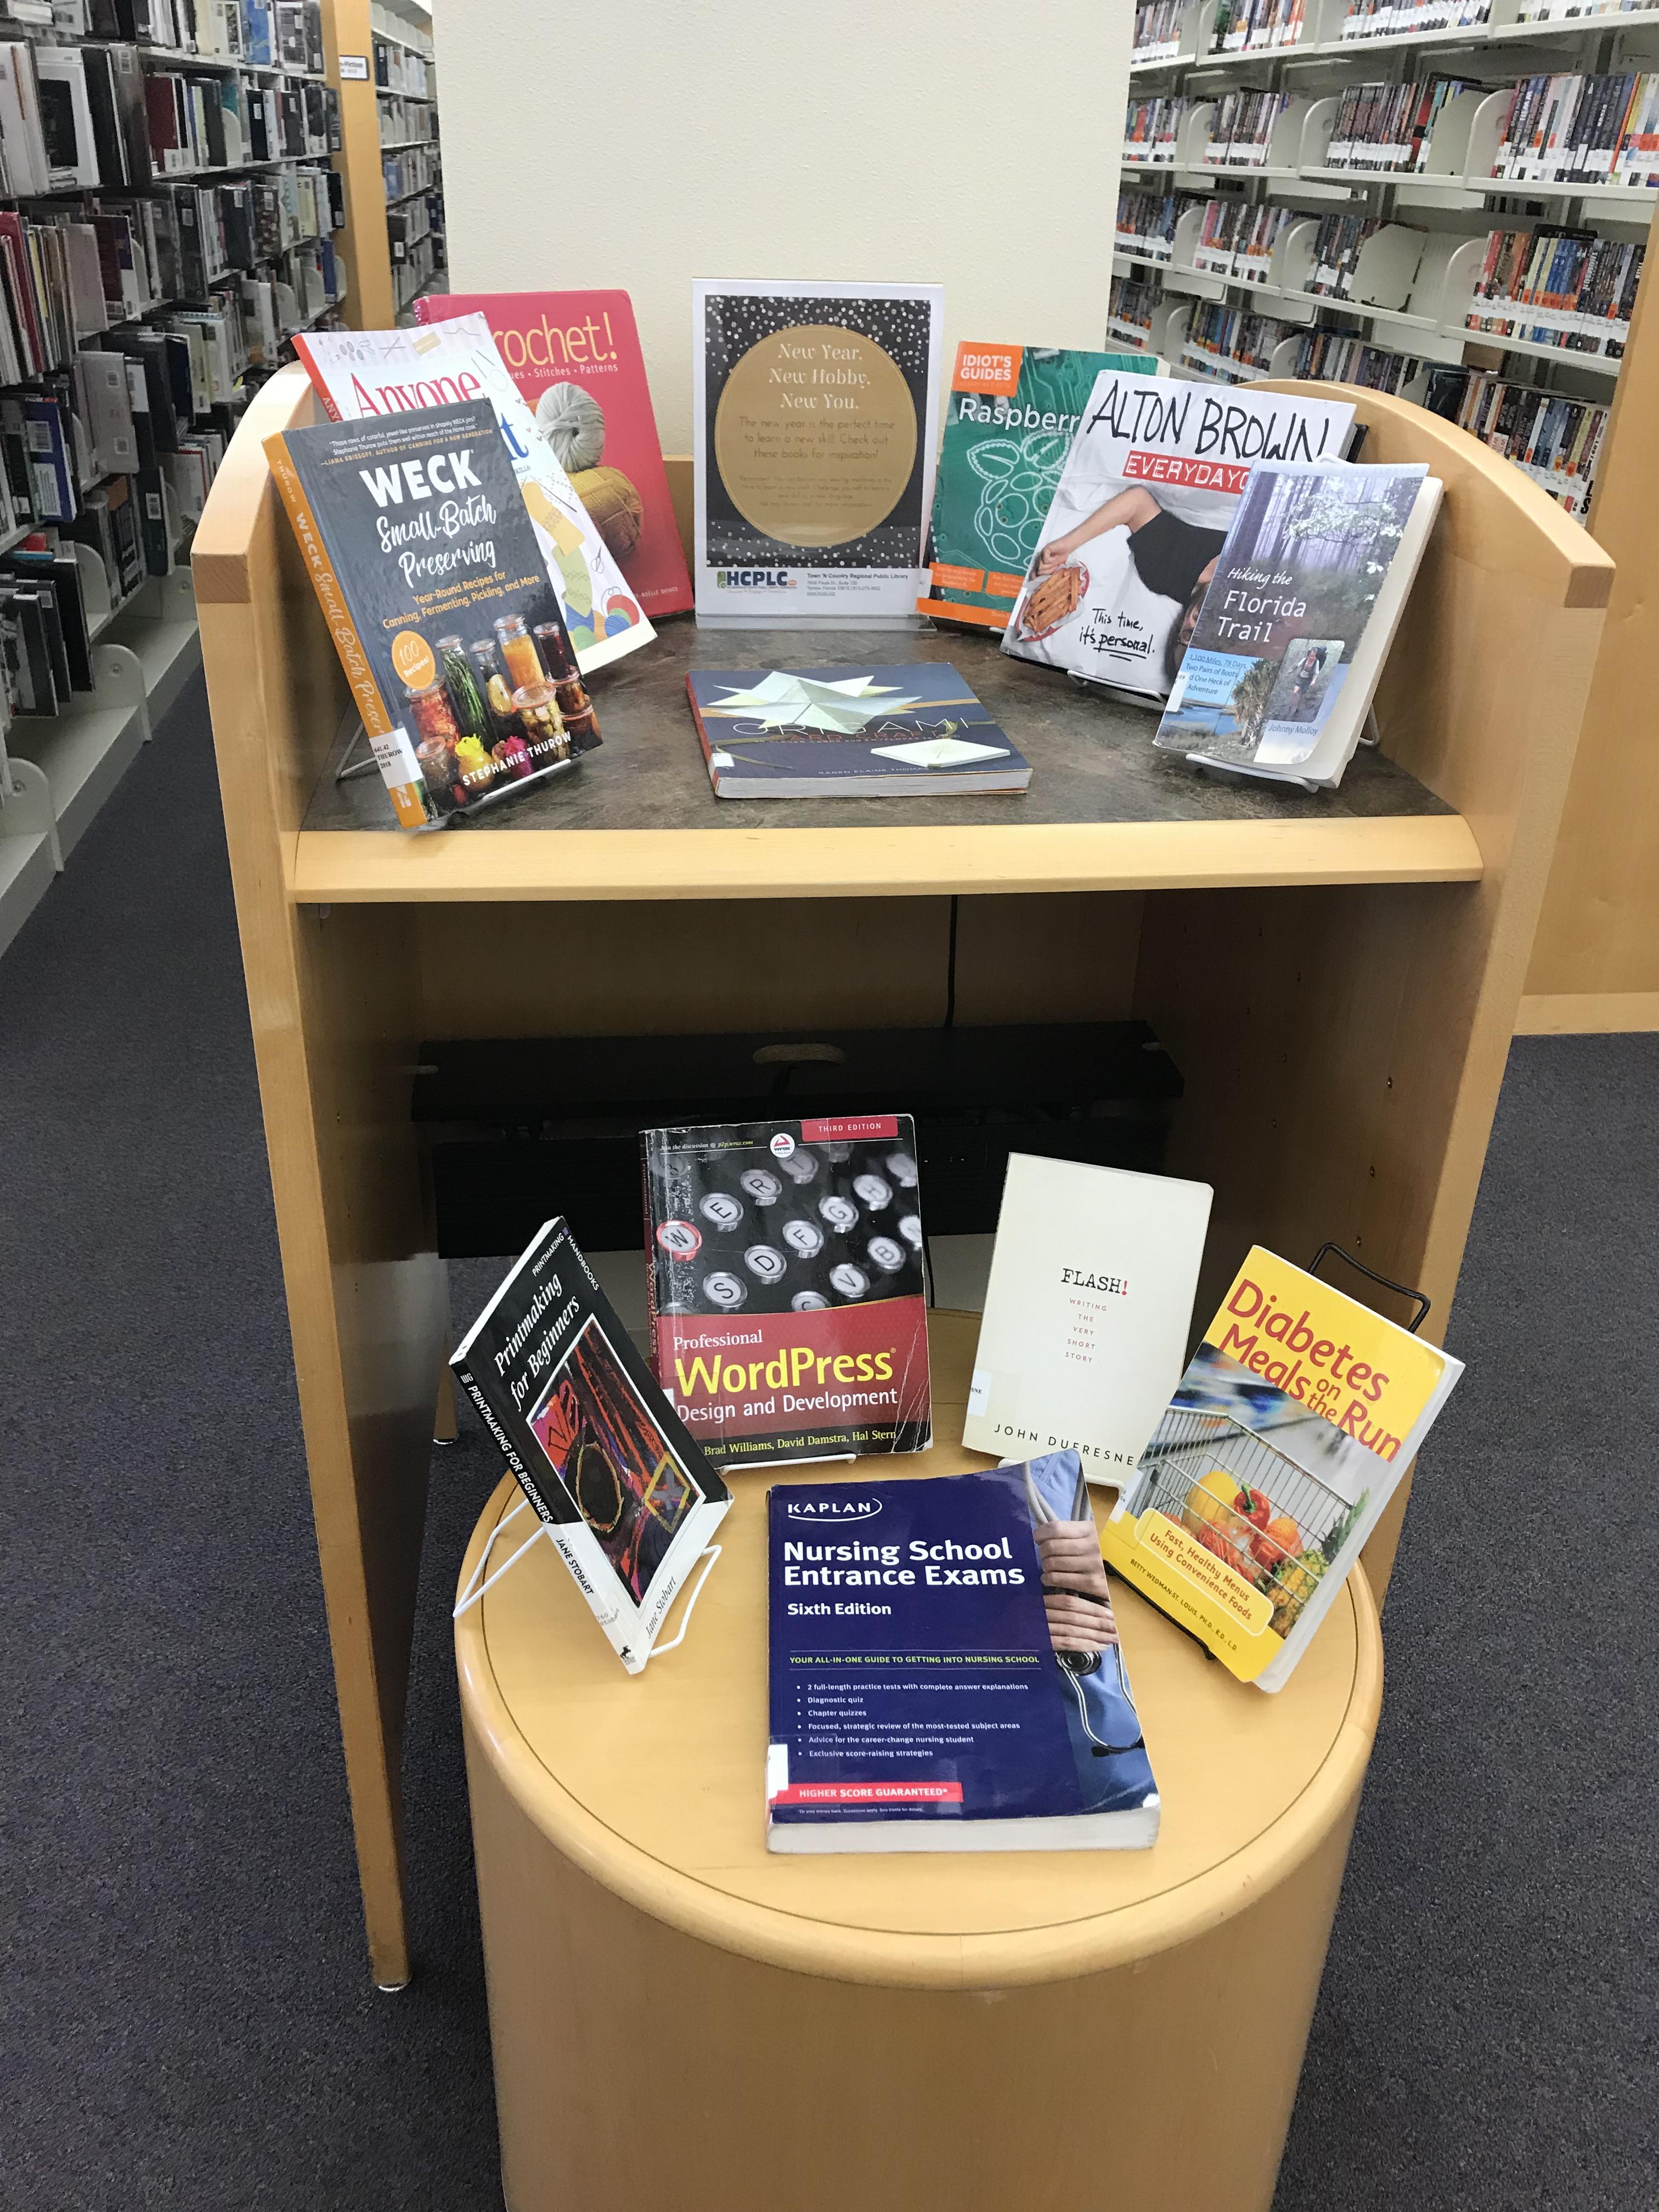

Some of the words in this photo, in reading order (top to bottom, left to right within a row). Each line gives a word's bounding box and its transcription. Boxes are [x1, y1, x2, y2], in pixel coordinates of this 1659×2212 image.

[778, 343, 815, 358] New
[822, 344, 862, 360] Year.
[963, 354, 1012, 368] IDIOT'S
[534, 365, 571, 377] Stitches
[579, 363, 618, 374] Patterns
[769, 368, 806, 383] New
[812, 368, 871, 388] Hobby.
[960, 368, 1012, 381] GUIDES
[780, 393, 817, 408] New
[823, 393, 859, 409] You.
[739, 416, 757, 427] The
[785, 421, 805, 430] year
[819, 417, 834, 428] the
[838, 418, 870, 430] perfect
[874, 419, 895, 430] time
[959, 397, 1081, 433] Raspberr
[1086, 379, 1191, 444] ALTON
[1194, 398, 1330, 462] BROWN
[277, 459, 297, 503] THUROW
[1125, 454, 1250, 490] EVERYDAYC
[376, 494, 496, 553] Small-Batch
[399, 540, 496, 588] Preserving
[413, 584, 461, 605] Year-Round
[462, 574, 493, 591] Recipes
[494, 571, 506, 581] for
[726, 571, 788, 586] HCPLC
[1227, 567, 1271, 590] Hiking
[1272, 571, 1293, 585] the
[296, 511, 323, 568] WECK
[315, 572, 363, 680] Small-Batch
[383, 611, 421, 629] Canning,
[421, 596, 471, 617] Fermenting,
[472, 585, 505, 602] Pickling,
[505, 581, 520, 591] and
[521, 575, 540, 586] More
[1223, 590, 1307, 618] Florida
[1092, 608, 1112, 625] This
[1118, 611, 1143, 631] time,
[1218, 616, 1273, 642] Trail
[1079, 625, 1096, 646] it's
[1098, 633, 1155, 653] personal.
[399, 640, 420, 666] 100
[403, 655, 431, 678] Recipes!
[1186, 663, 1198, 671] Two
[1199, 665, 1213, 674] Pairs
[1187, 684, 1219, 695] Adventure
[1208, 678, 1223, 686] Heck
[733, 717, 969, 735] ORIGAMI
[1268, 724, 1295, 735] Johnny
[1295, 726, 1319, 736] Molloy
[377, 748, 403, 760] THUROW
[462, 751, 526, 786] STEPHANIE
[527, 731, 572, 759] THUROW
[848, 1122, 882, 1131] EDITION
[532, 1232, 565, 1277] PRINTMAKING
[567, 1235, 600, 1291] HANDBOOKS
[1061, 1268, 1127, 1296] FLASH!
[1070, 1298, 1107, 1311] WRITING
[494, 1273, 563, 1377] Printmaking
[1078, 1314, 1094, 1323] THE
[673, 1329, 763, 1351] Professional
[1074, 1327, 1094, 1336] VERY
[1227, 1278, 1391, 1402] Diabetes
[511, 1371, 529, 1412] for
[527, 1295, 579, 1379] Beginners
[1067, 1339, 1096, 1350] SHORT
[1065, 1352, 1093, 1363] STORY
[1219, 1323, 1311, 1401] Meals
[1317, 1379, 1341, 1402] on
[678, 1404, 736, 1423] Design
[743, 1397, 775, 1415] and
[783, 1387, 898, 1412] Development
[1306, 1393, 1338, 1423] the
[994, 1424, 1038, 1441] JOHN
[1338, 1398, 1402, 1463] Run
[468, 1385, 512, 1452] PRINTMAKING
[506, 1451, 523, 1472] FOR
[518, 1471, 554, 1523] BEGINNERS
[704, 1444, 726, 1457] Brad
[729, 1440, 775, 1454] Williams,
[777, 1436, 805, 1449] David
[808, 1433, 850, 1447] Damstra,
[852, 1431, 868, 1441] Hal
[872, 1429, 897, 1440] Stern
[788, 1502, 871, 1514] KAPLAN
[785, 1541, 900, 1566] Nursing
[909, 1537, 1012, 1561] School
[556, 1539, 573, 1559] JANE
[568, 1559, 595, 1595] STOBART
[785, 1566, 916, 1586] Entrance
[925, 1565, 1025, 1586] Exams
[1130, 1558, 1146, 1574] BETTY
[1150, 1533, 1175, 1558] Using
[1176, 1554, 1228, 1600] Convenience
[1228, 1596, 1252, 1620] Foods
[1165, 1529, 1184, 1551] Fast,
[1187, 1547, 1221, 1579] Healthy
[1223, 1574, 1250, 1601] Menus
[645, 1613, 658, 1639] Jane
[656, 1576, 677, 1615] Stobart
[787, 1602, 831, 1616] Sixth
[835, 1602, 892, 1615] Edition
[865, 1656, 890, 1664] GUIDE
[814, 1683, 851, 1691] full-length
[853, 1683, 881, 1691] practice
[920, 1683, 952, 1692] complete
[982, 1683, 1028, 1691] explanations
[799, 1788, 837, 1798] HIGHER
[840, 1788, 873, 1798] SCORE
